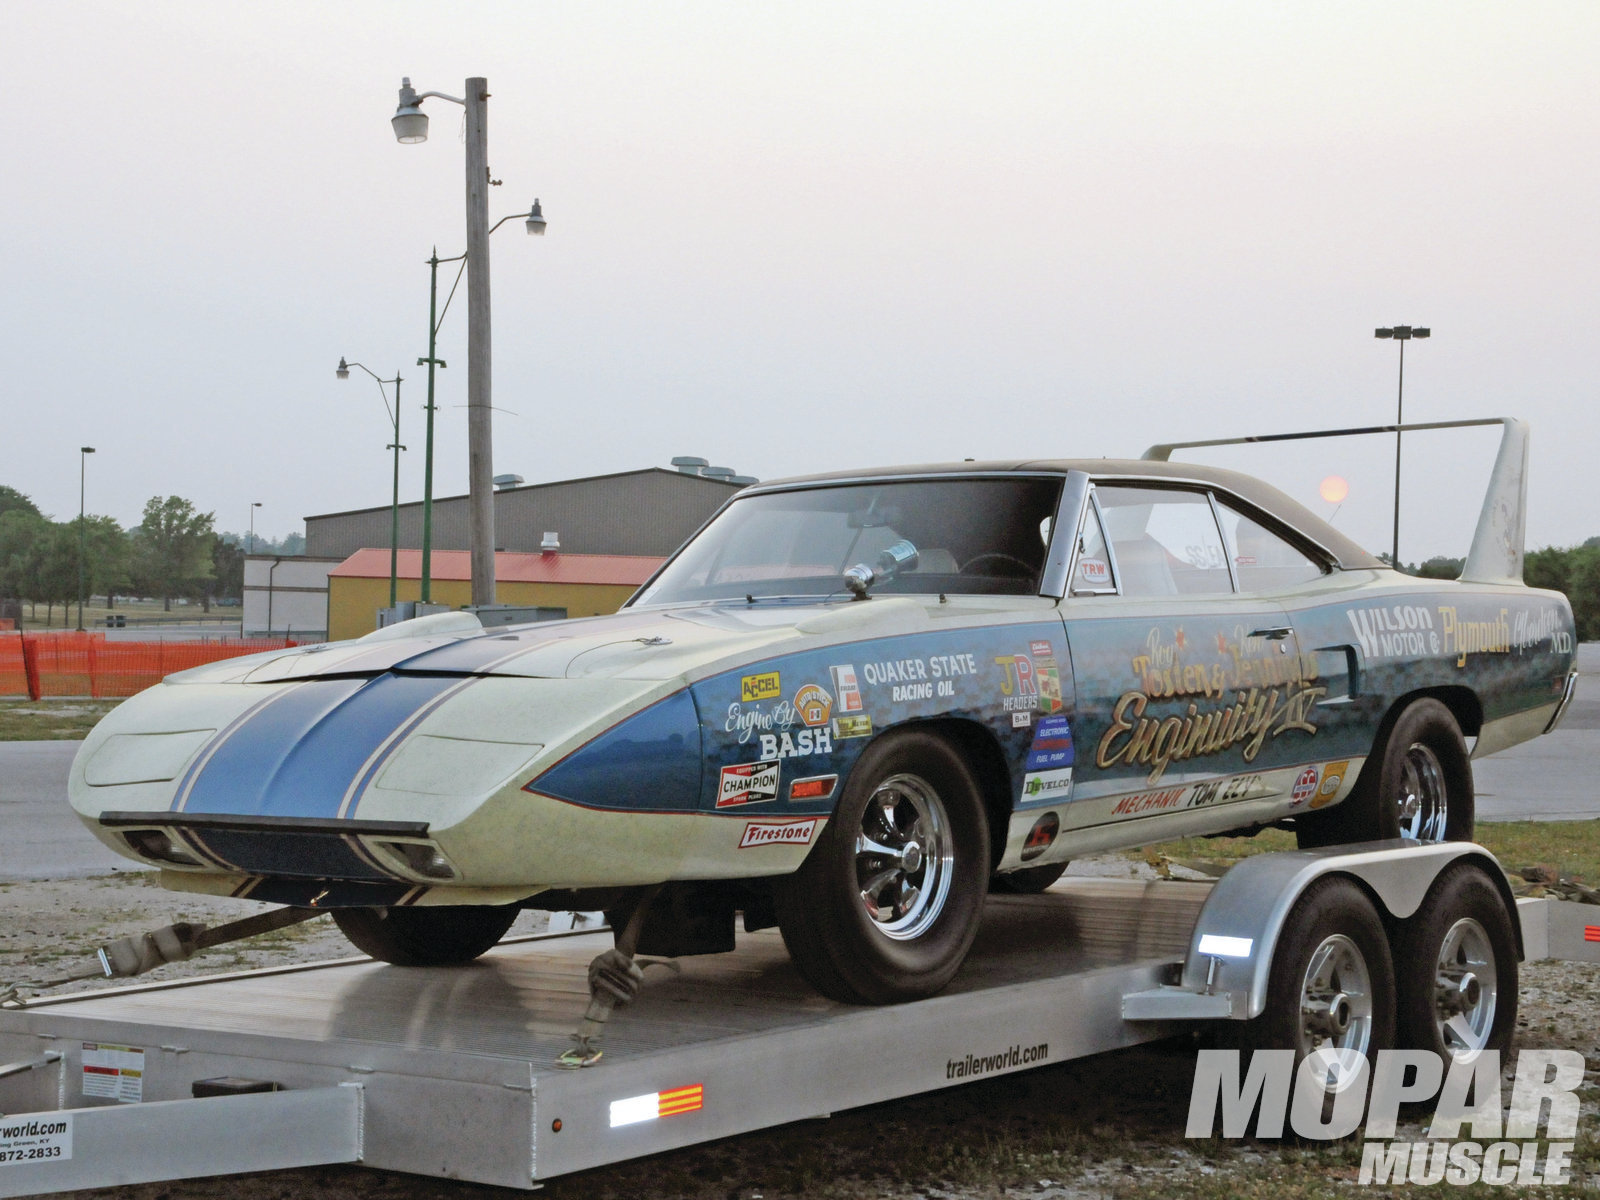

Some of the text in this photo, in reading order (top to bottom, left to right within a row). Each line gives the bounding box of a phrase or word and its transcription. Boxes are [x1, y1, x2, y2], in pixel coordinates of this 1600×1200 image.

[1082, 564, 1105, 575] TRW
[1380, 631, 1427, 657] MOTOR
[1438, 606, 1510, 668] Plymouth
[864, 653, 977, 685] QUAKER STATE
[994, 654, 1037, 695] JR
[743, 677, 779, 698] ACCEL
[893, 680, 955, 701] RACING OIL
[1003, 695, 1038, 711] HEADERS
[725, 702, 773, 743] Engine
[1040, 726, 1070, 737] ELECTRONIC
[760, 727, 832, 760] BASH
[1097, 690, 1278, 787] Enginuity
[1036, 753, 1065, 763] FUEL PUMP
[723, 774, 776, 793] CHAMPION
[1112, 788, 1186, 816] MECHANIC
[1187, 779, 1220, 807] TOM
[747, 826, 810, 843] Firestone
[946, 1043, 1049, 1079] trailerworld.com
[0, 1121, 67, 1138] world.com
